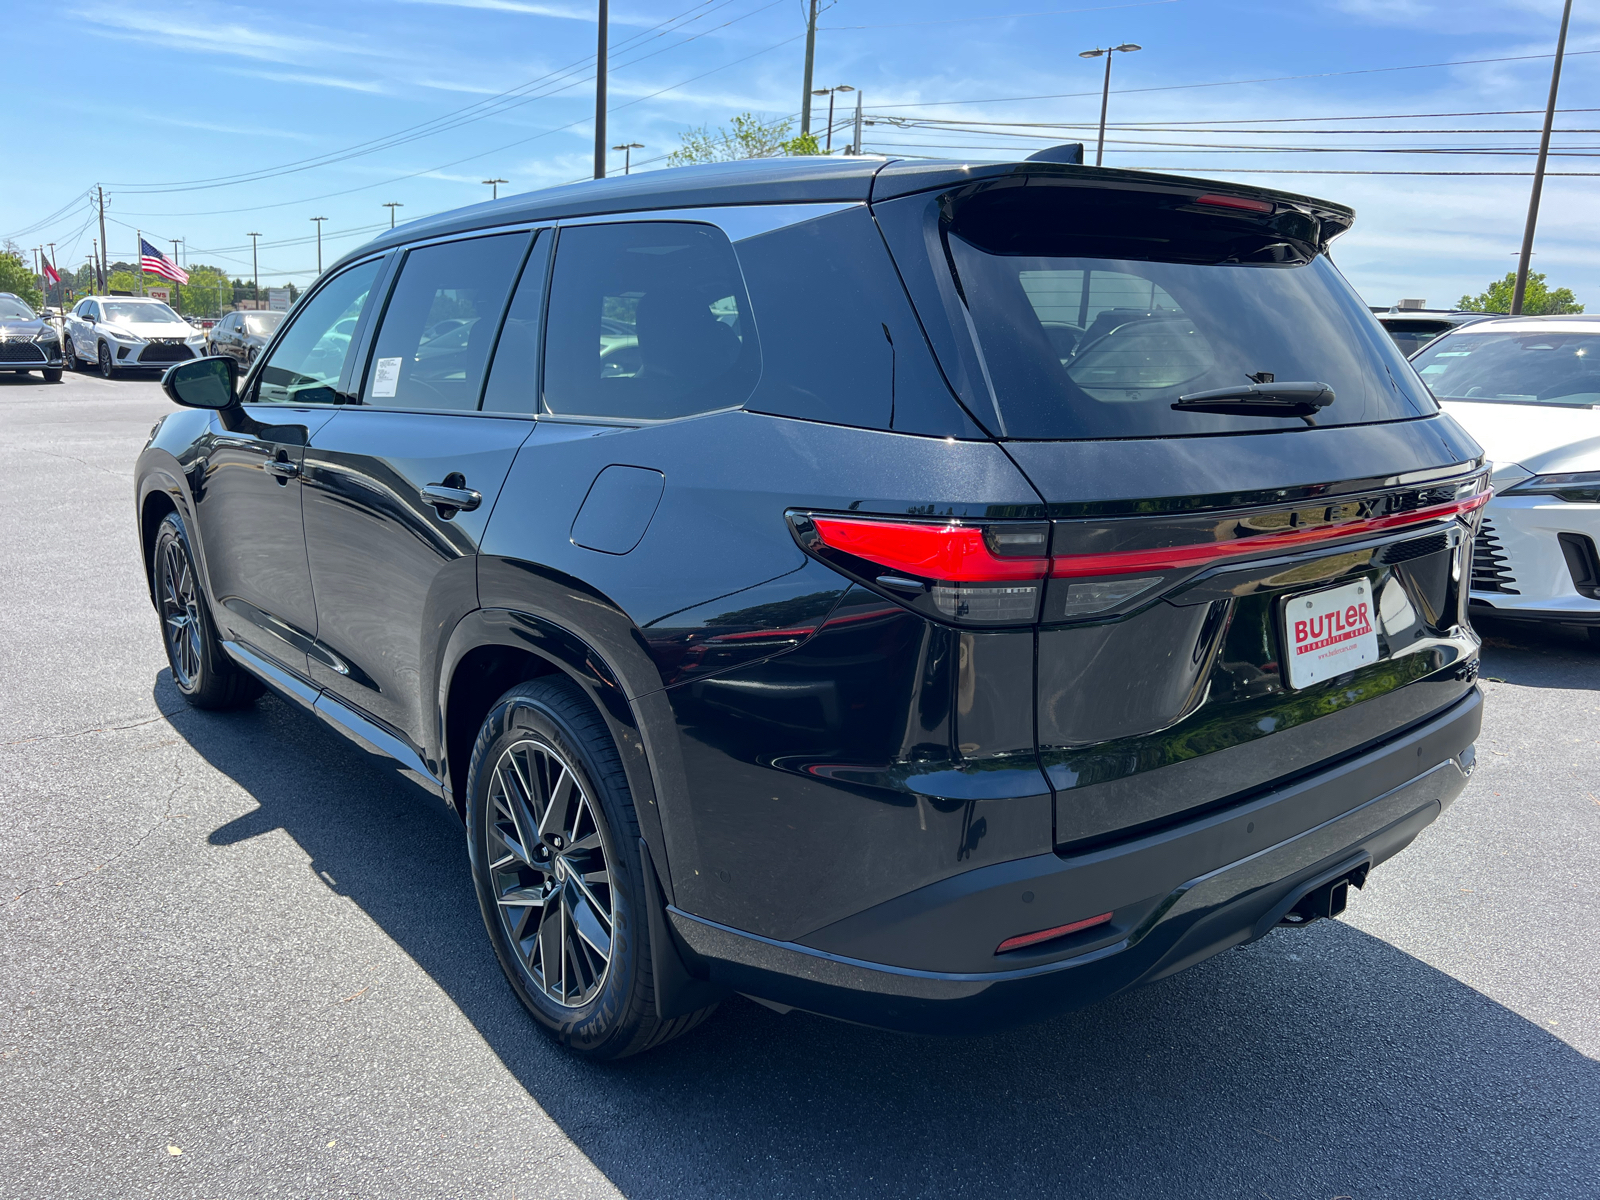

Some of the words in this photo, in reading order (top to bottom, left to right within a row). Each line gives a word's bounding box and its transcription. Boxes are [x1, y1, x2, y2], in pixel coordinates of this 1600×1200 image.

[1289, 492, 1428, 528] LEXUS
[1296, 634, 1345, 655] AUTOMOTIVE
[1350, 625, 1372, 639] GROUP
[579, 910, 628, 1044] GOODYEAR
